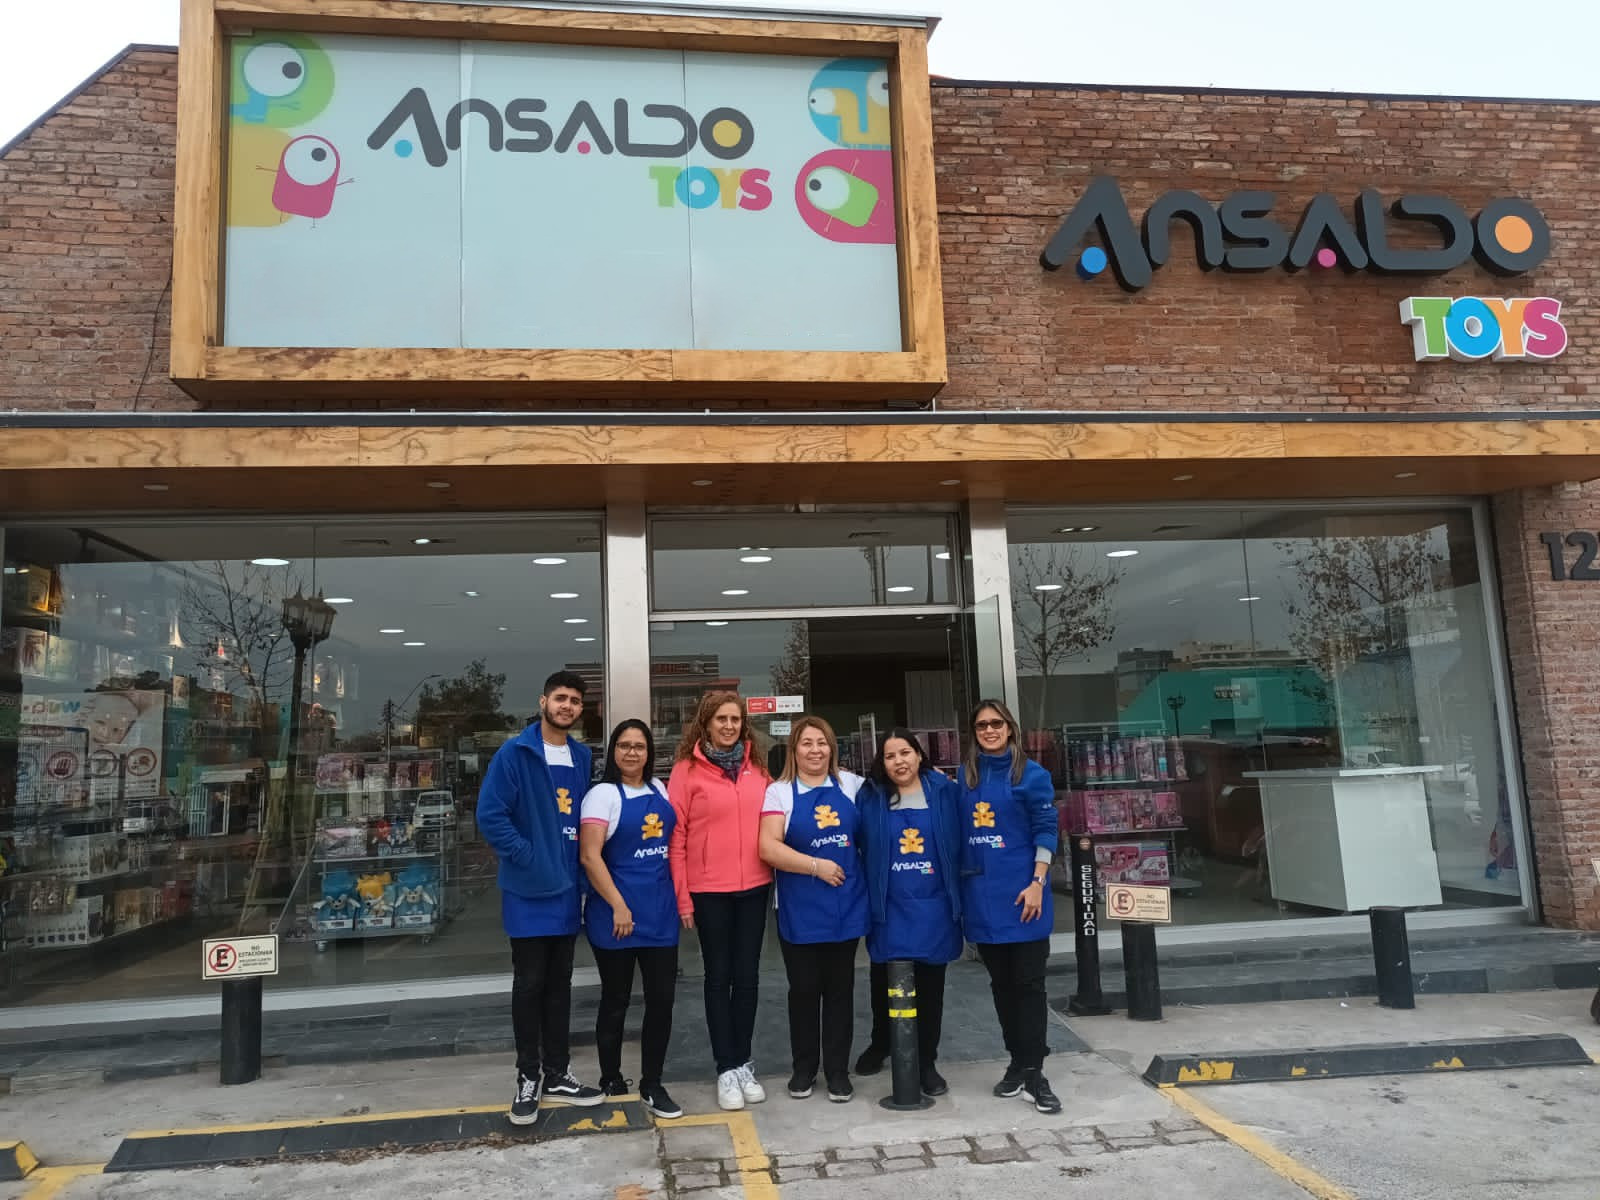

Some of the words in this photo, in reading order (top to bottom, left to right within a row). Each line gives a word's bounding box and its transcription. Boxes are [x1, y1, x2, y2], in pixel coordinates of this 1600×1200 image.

[648, 165, 772, 211] TOYS
[1399, 296, 1568, 363] TOYS
[1081, 864, 1096, 936] SEGURIDAD
